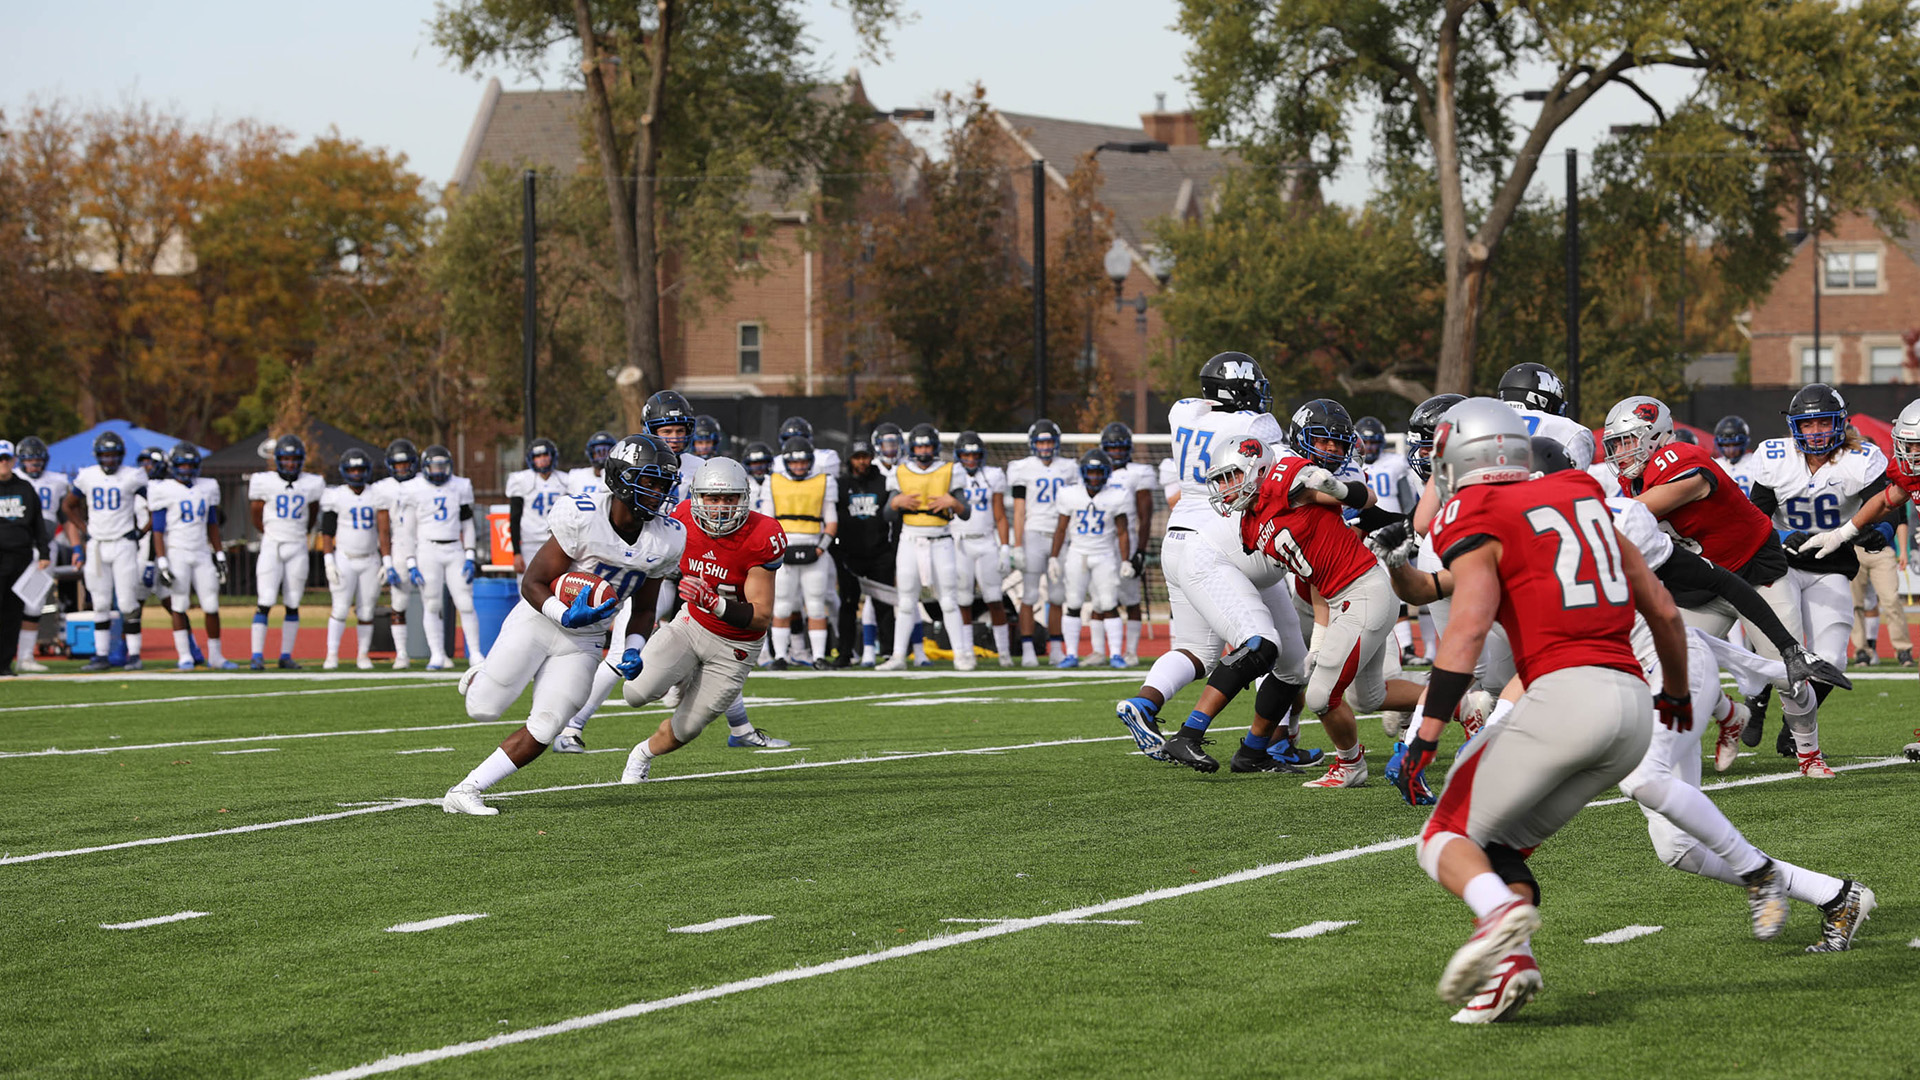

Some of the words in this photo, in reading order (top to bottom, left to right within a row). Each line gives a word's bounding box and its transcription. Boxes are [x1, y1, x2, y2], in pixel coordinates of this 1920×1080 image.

[1223, 361, 1255, 380] M
[1536, 371, 1564, 399] M
[609, 441, 642, 464] M
[1176, 426, 1215, 484] 73
[1654, 450, 1679, 471] 50
[1765, 440, 1785, 460] 56
[1482, 471, 1522, 481] Riddell
[93, 487, 121, 510] 80
[276, 495, 305, 519] 82
[434, 496, 448, 521] 3
[180, 499, 206, 523] 84
[349, 506, 374, 530] 19
[1076, 510, 1105, 534] 33
[1433, 499, 1461, 535] 20
[1786, 493, 1840, 530] 56
[769, 532, 787, 556] 56
[1523, 496, 1629, 610] 20
[688, 557, 728, 580] WASHU
